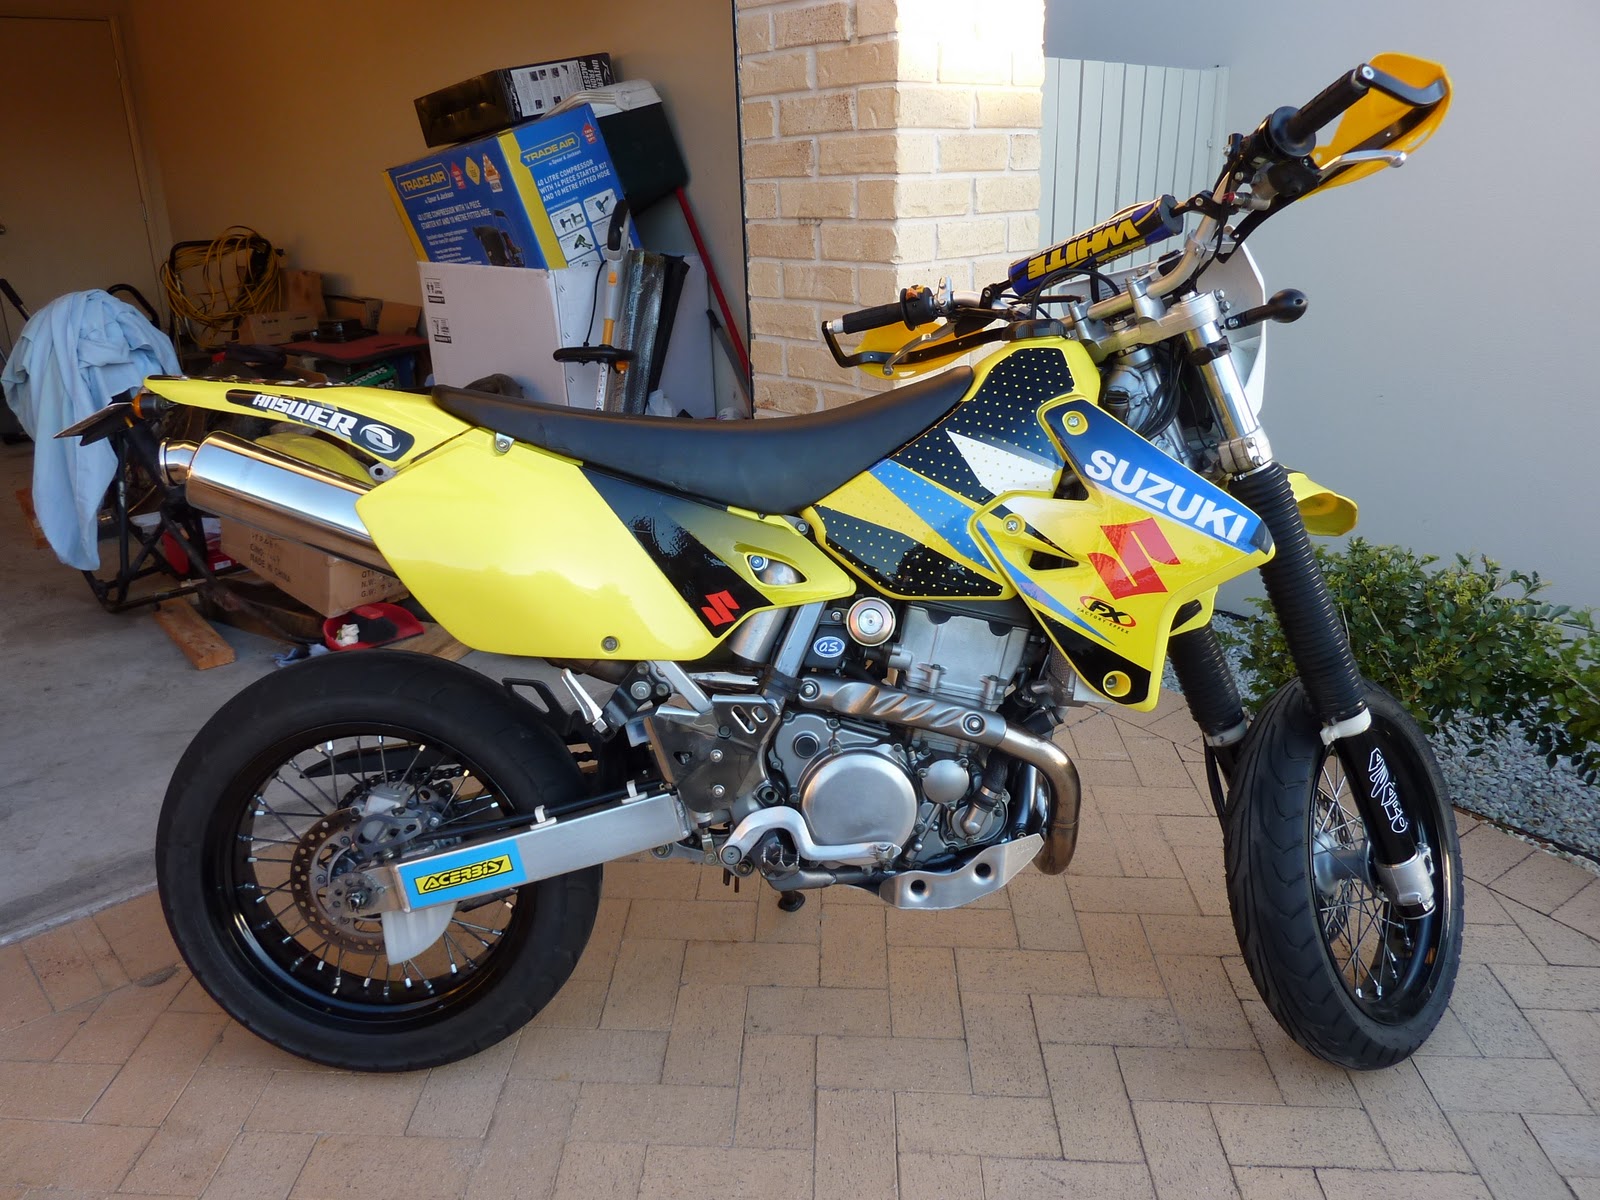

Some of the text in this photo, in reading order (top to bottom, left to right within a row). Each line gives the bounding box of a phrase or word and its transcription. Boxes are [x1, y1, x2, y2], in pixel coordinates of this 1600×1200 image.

[523, 137, 576, 162] TRADE AIR
[400, 175, 431, 192] TRADE
[430, 170, 447, 185] AIR
[537, 158, 594, 187] 40 LITRE COMPRESSOR
[538, 161, 607, 195] WITH 14 PIECE STARTER KIT
[542, 193, 555, 202] AND
[560, 182, 579, 195] METRE
[578, 175, 597, 188] FITTED
[596, 168, 611, 180] HOSE
[1027, 218, 1140, 280] WHITE
[252, 393, 359, 437] ANSWER
[1084, 449, 1248, 544] SUZUKI
[1076, 607, 1130, 634] FACTORY EFFEX
[1087, 600, 1131, 625] FX
[819, 641, 839, 653] O.S.
[423, 859, 505, 891] ACERBIS
